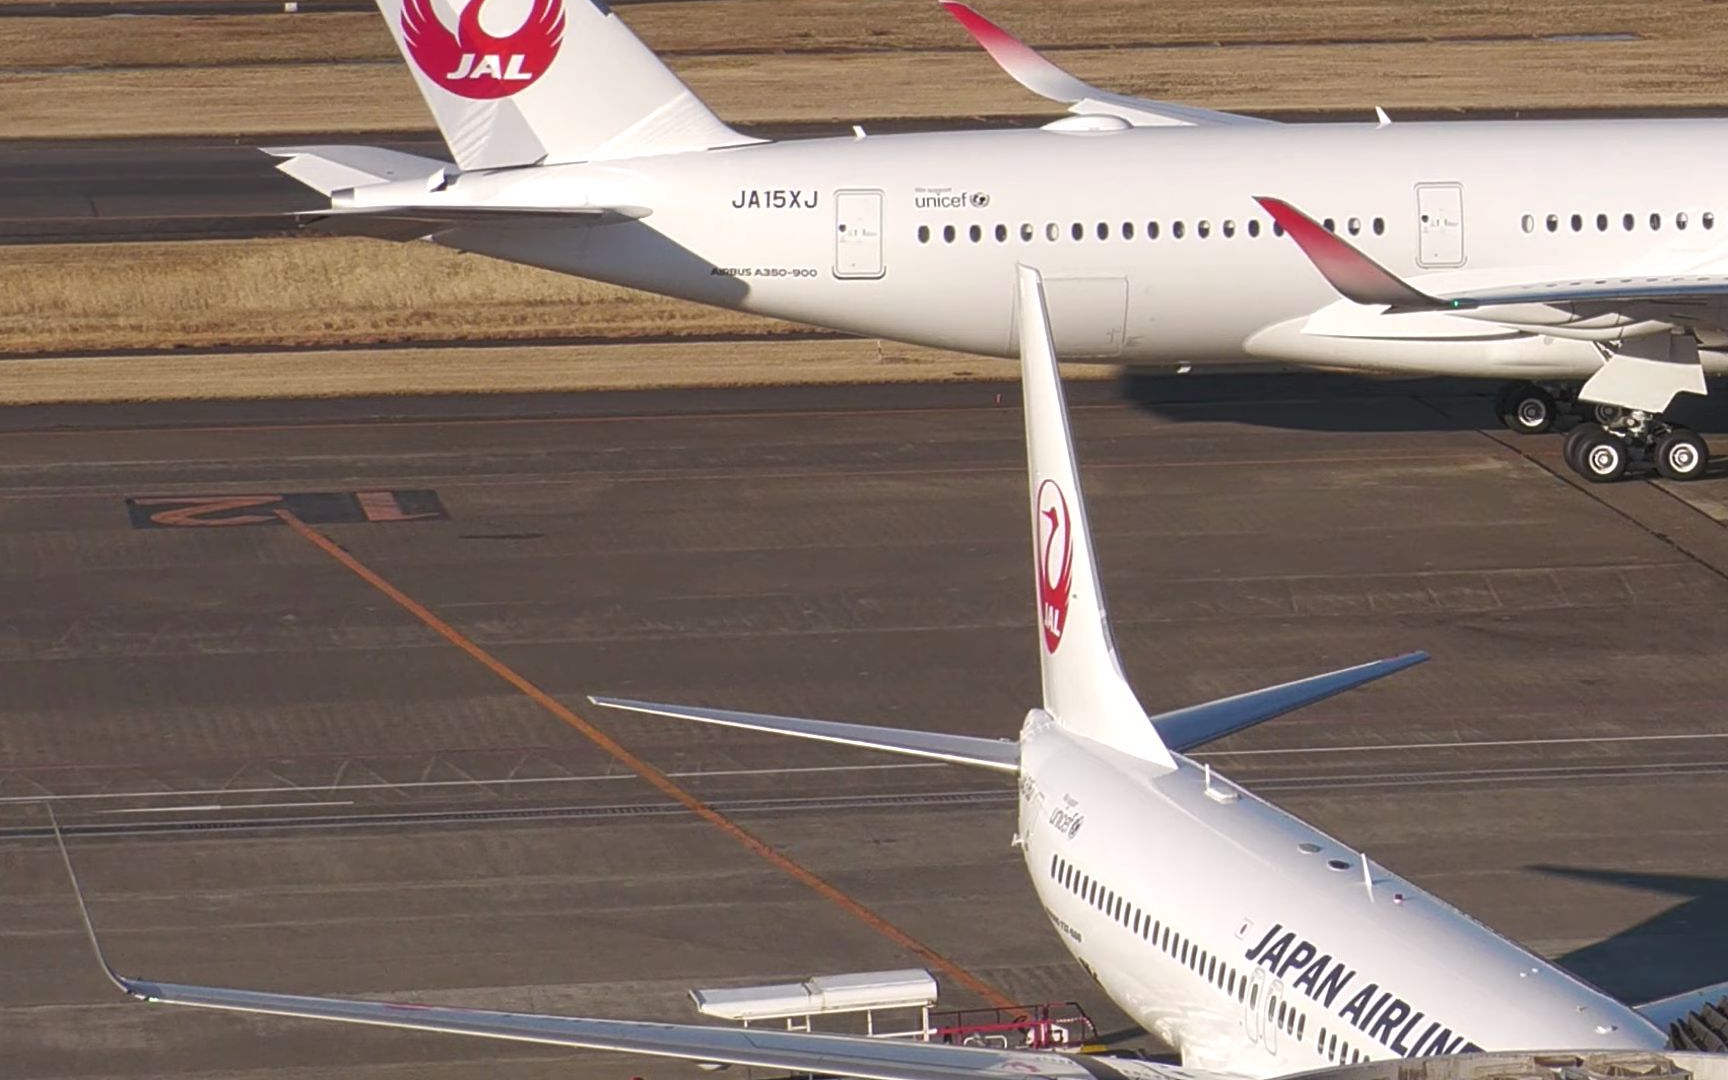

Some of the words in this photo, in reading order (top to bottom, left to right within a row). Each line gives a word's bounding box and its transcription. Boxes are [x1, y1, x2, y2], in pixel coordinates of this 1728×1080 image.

[446, 53, 533, 80] JAL
[732, 190, 818, 209] JA15XJ
[915, 192, 967, 208] unicef
[754, 268, 818, 277] A350-900
[1245, 923, 1357, 1009] JAPAN
